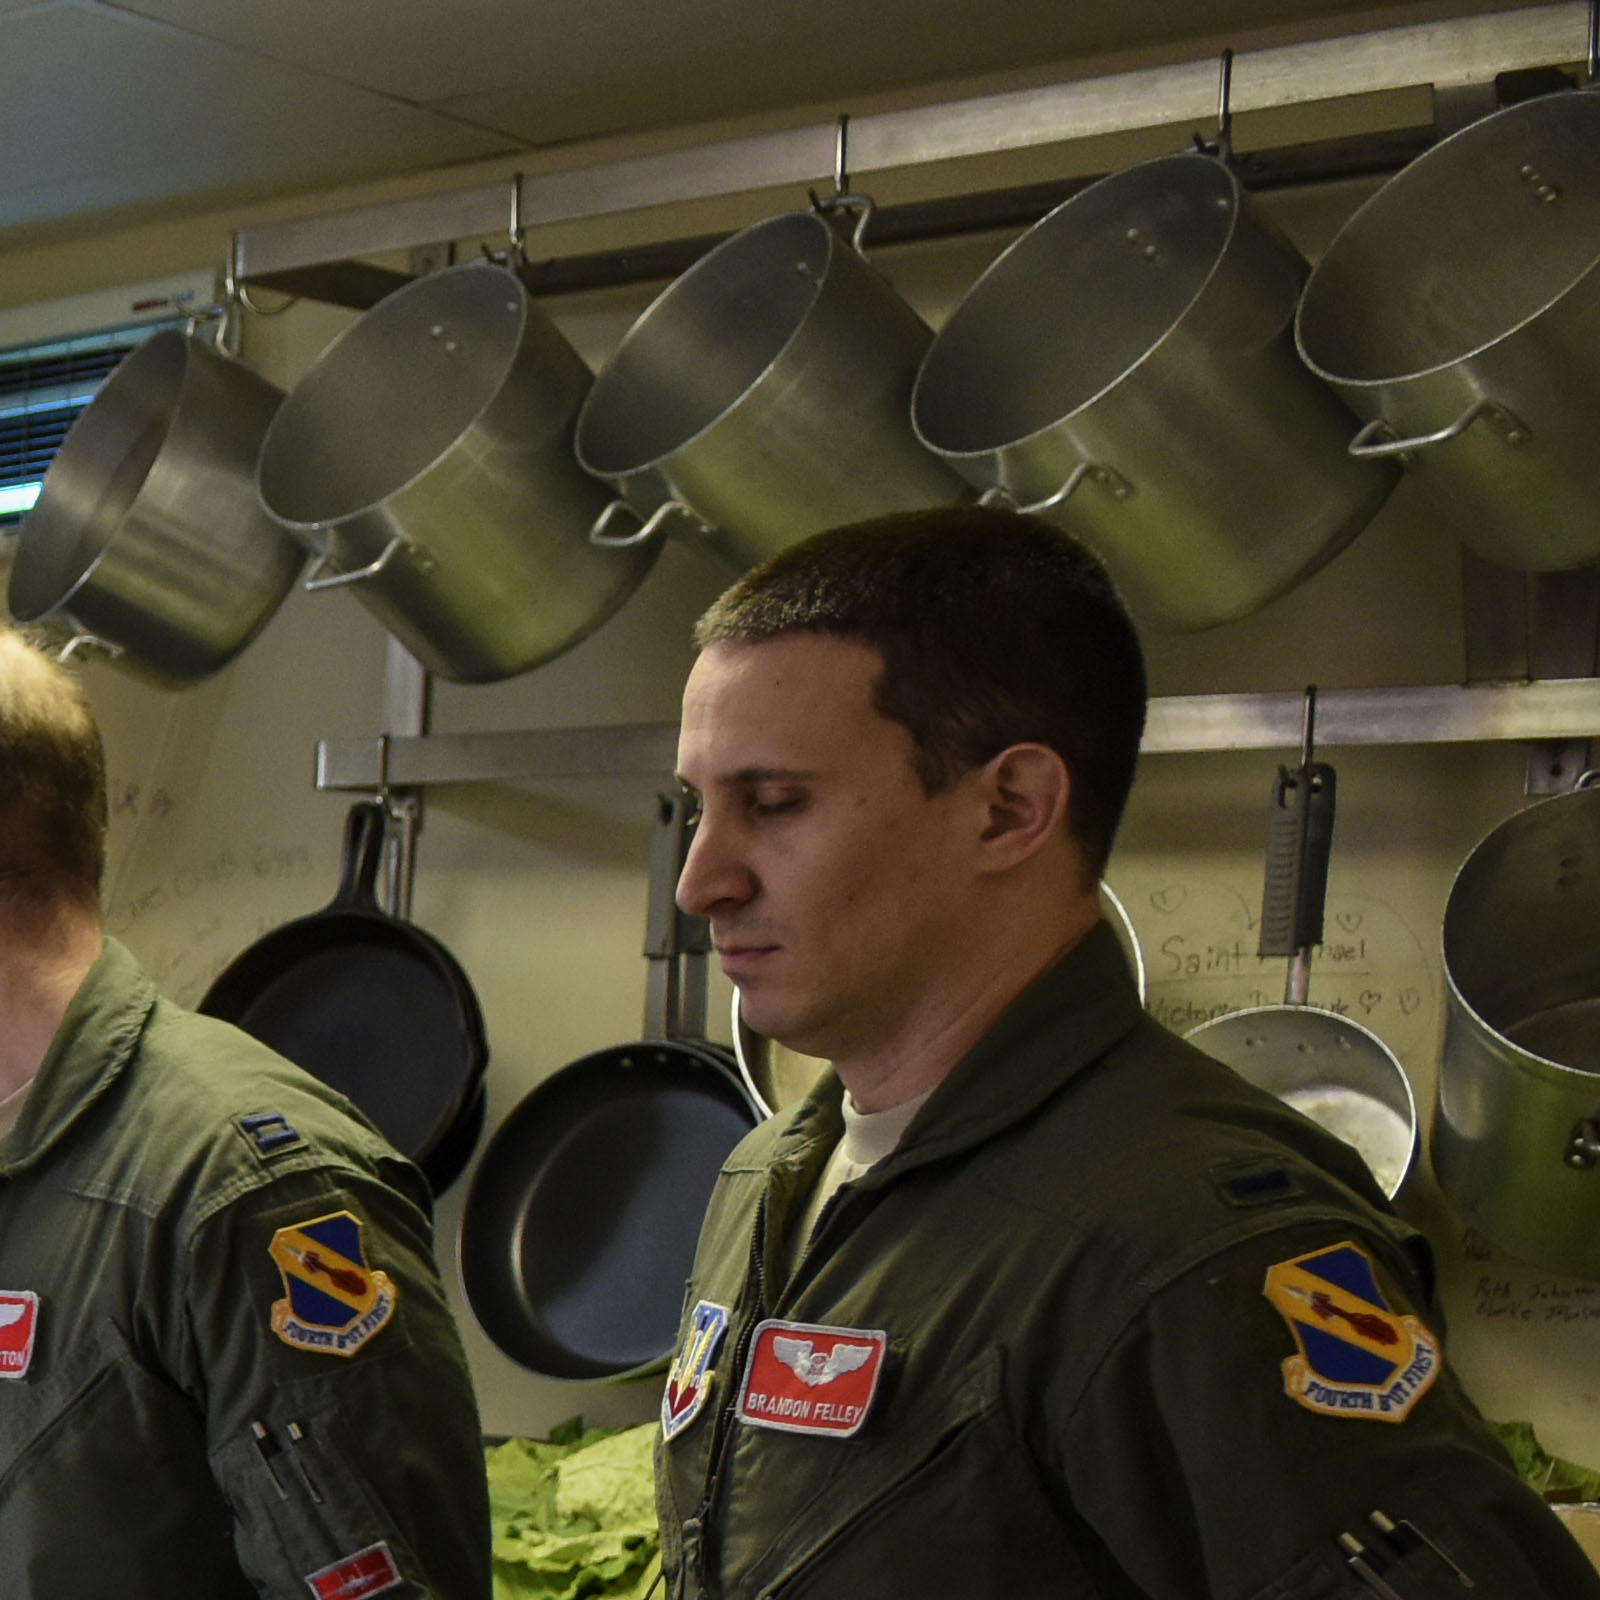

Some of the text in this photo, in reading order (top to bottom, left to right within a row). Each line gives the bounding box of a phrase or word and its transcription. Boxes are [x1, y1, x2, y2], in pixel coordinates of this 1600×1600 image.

[284, 1320, 334, 1347] FOURTH
[1304, 1343, 1432, 1412] FOURTH BUT FIRST
[747, 1392, 863, 1424] BRANDON FELLEY
